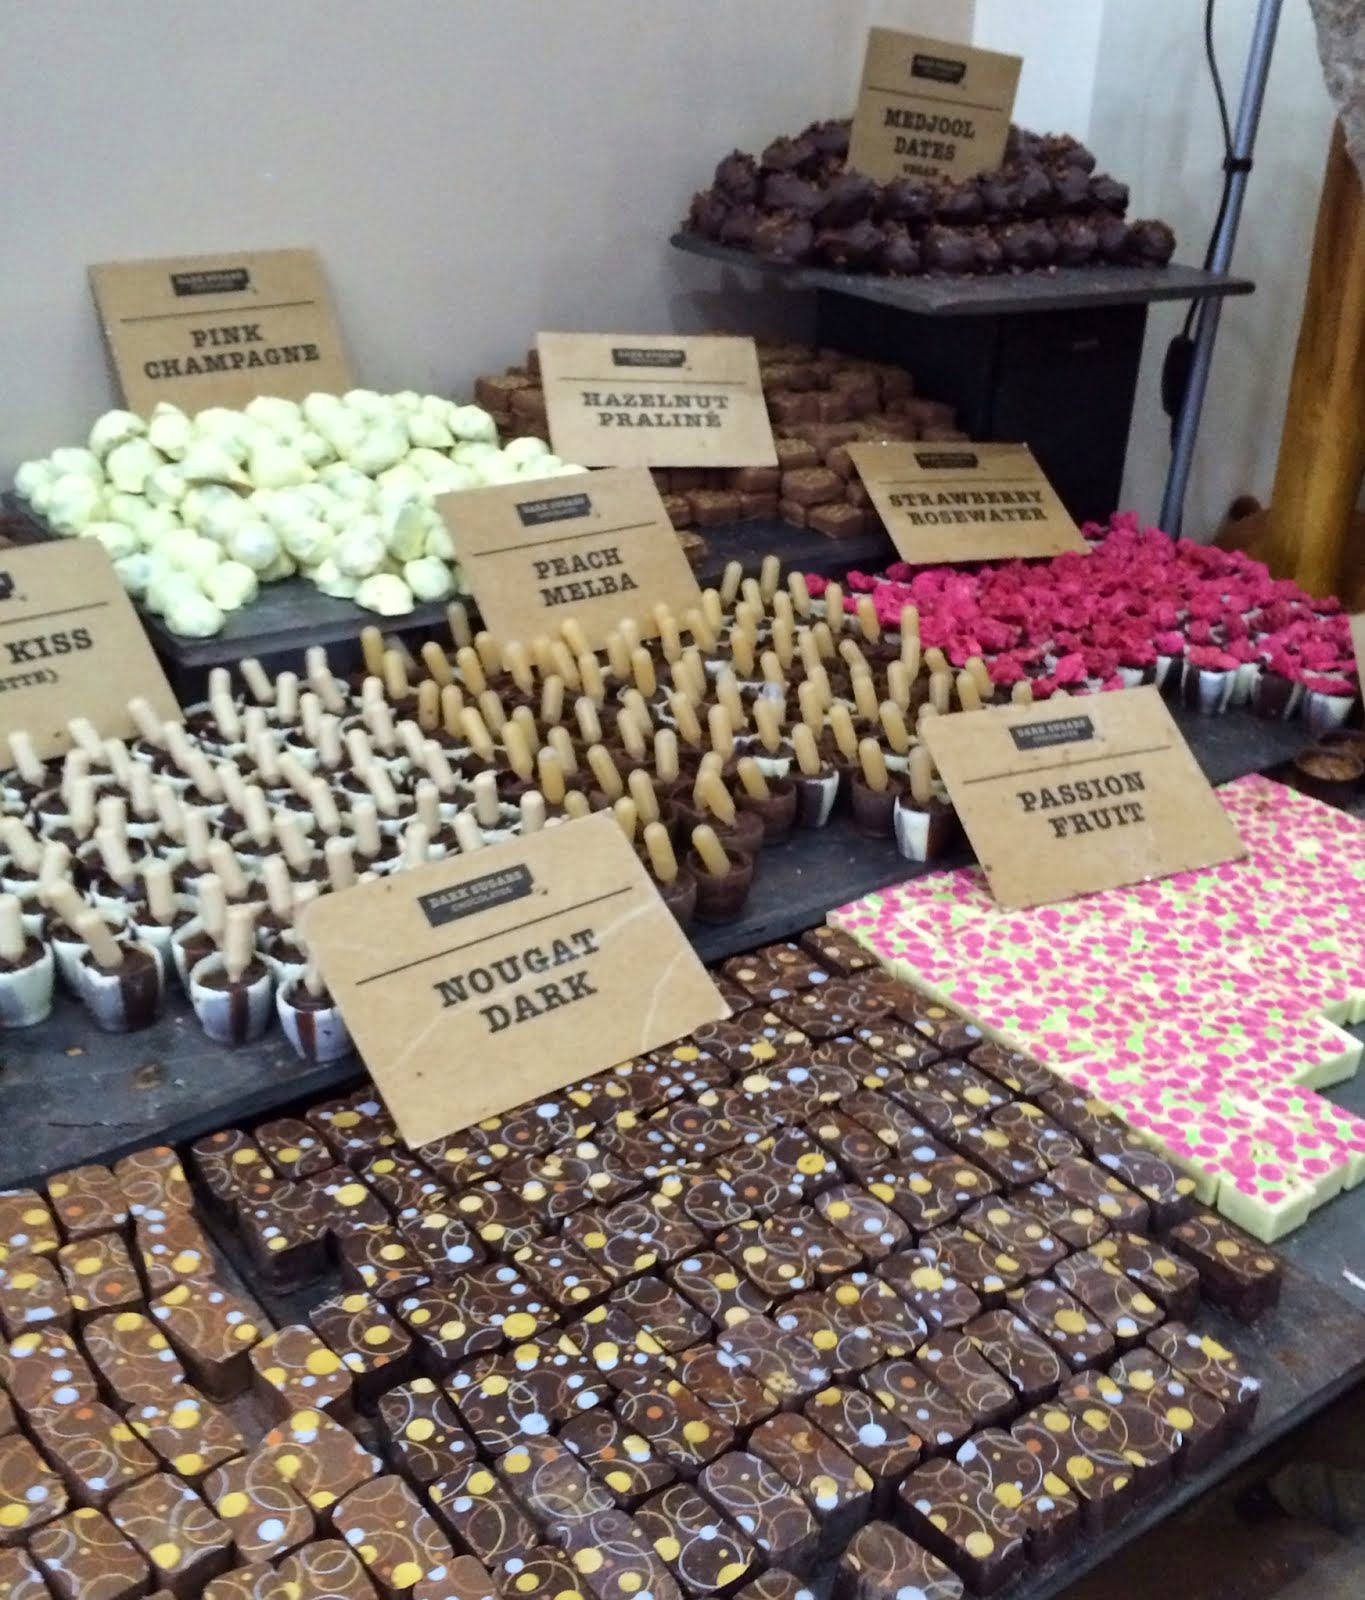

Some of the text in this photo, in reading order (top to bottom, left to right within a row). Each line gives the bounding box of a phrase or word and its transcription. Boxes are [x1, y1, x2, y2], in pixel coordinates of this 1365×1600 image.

[884, 107, 975, 139] MEDJOOL
[894, 136, 956, 161] DATES
[191, 324, 264, 348] PINK
[144, 344, 321, 379] CHAMPAGNE
[582, 392, 729, 410] HAZELNUT
[888, 489, 1044, 508] STRAWBERRY
[906, 507, 1049, 526] ROSEWATER
[533, 548, 625, 580] PEACH
[540, 572, 639, 607] MELBA
[4, 627, 94, 665] KISS
[1016, 770, 1147, 812] PASSION
[1048, 802, 1146, 839] FRUIT
[429, 870, 524, 909] DARK SUGARS
[433, 928, 600, 1008] NOUGAT
[479, 970, 599, 1034] DARK
